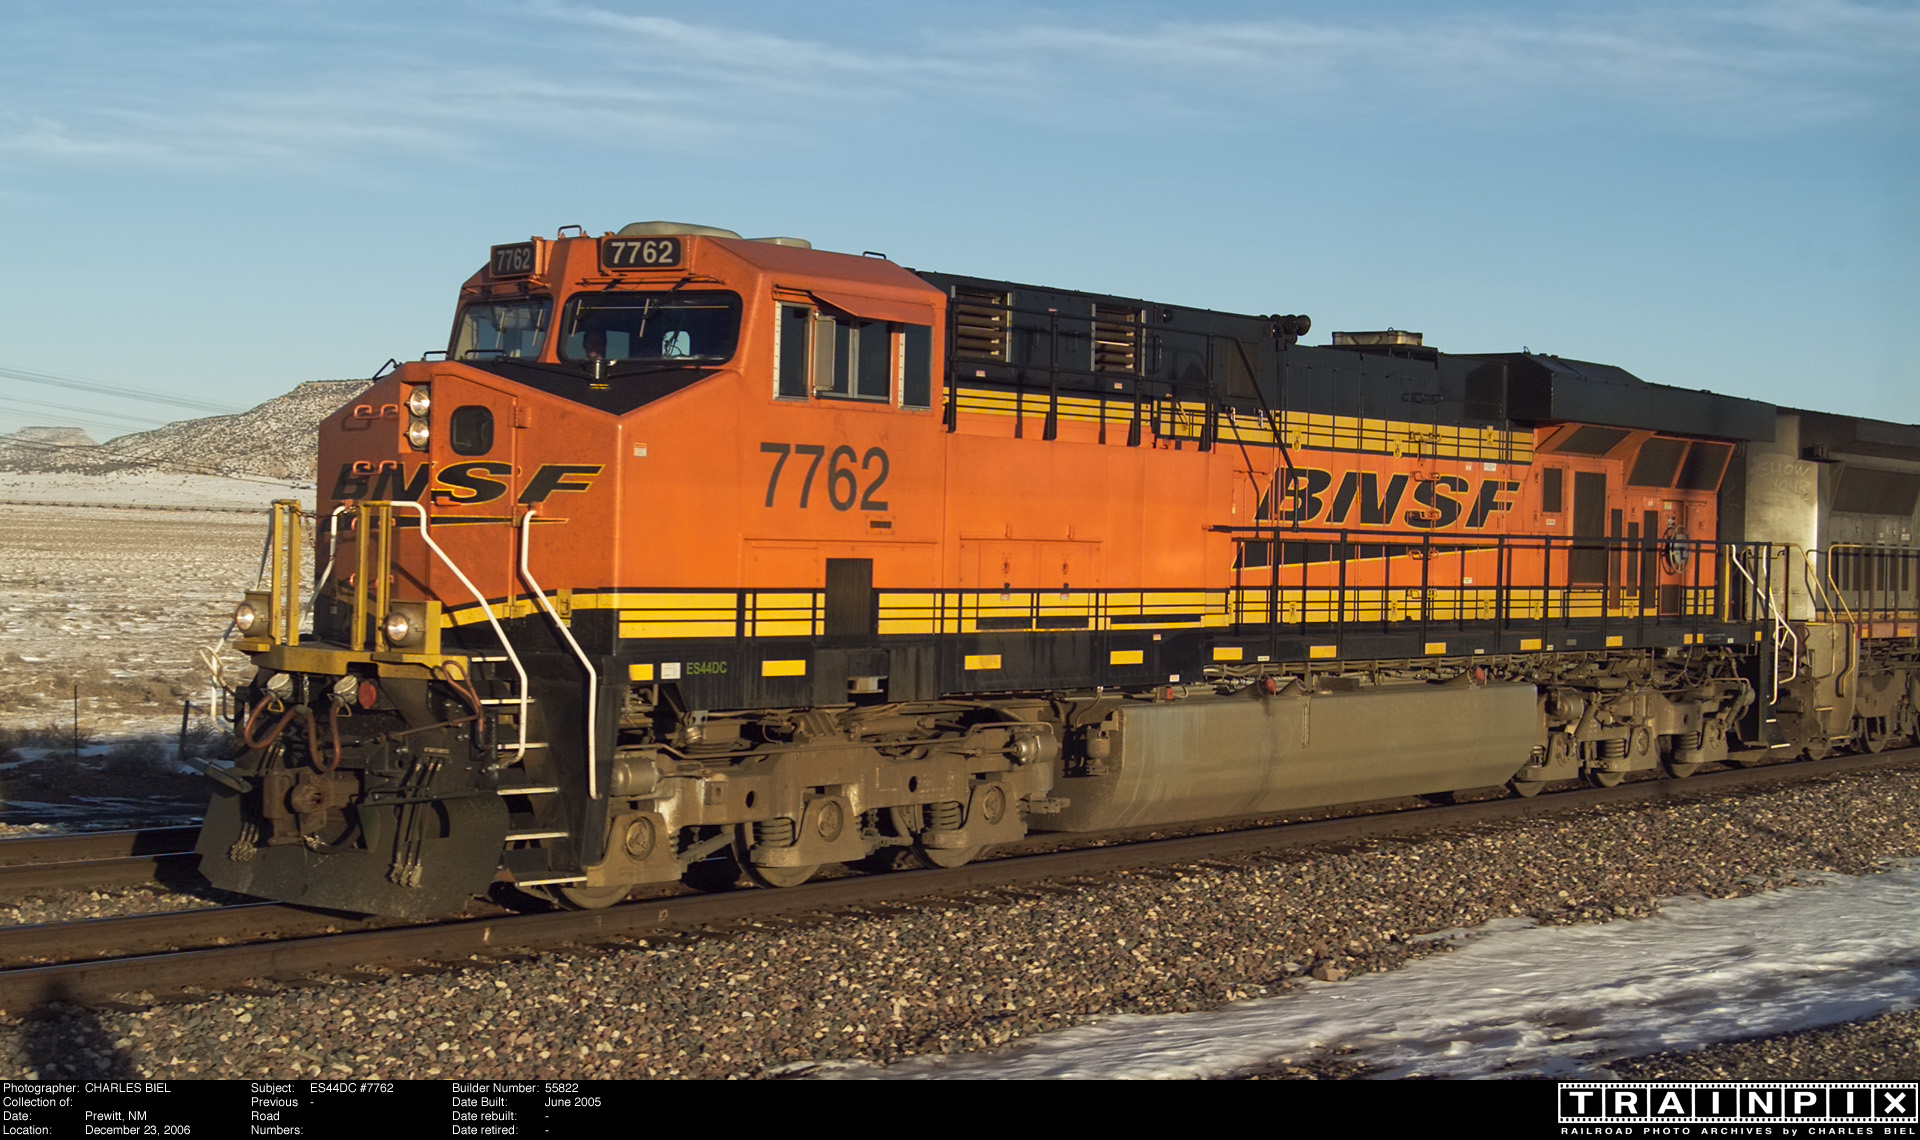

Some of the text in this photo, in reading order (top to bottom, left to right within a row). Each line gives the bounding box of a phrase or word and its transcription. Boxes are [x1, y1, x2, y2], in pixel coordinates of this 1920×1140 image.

[497, 247, 532, 273] 7762
[610, 239, 674, 265] 7762
[330, 460, 605, 506] BNSF
[760, 442, 890, 512] 7762
[1253, 466, 1521, 530] BNSF
[686, 660, 728, 676] ES44DC
